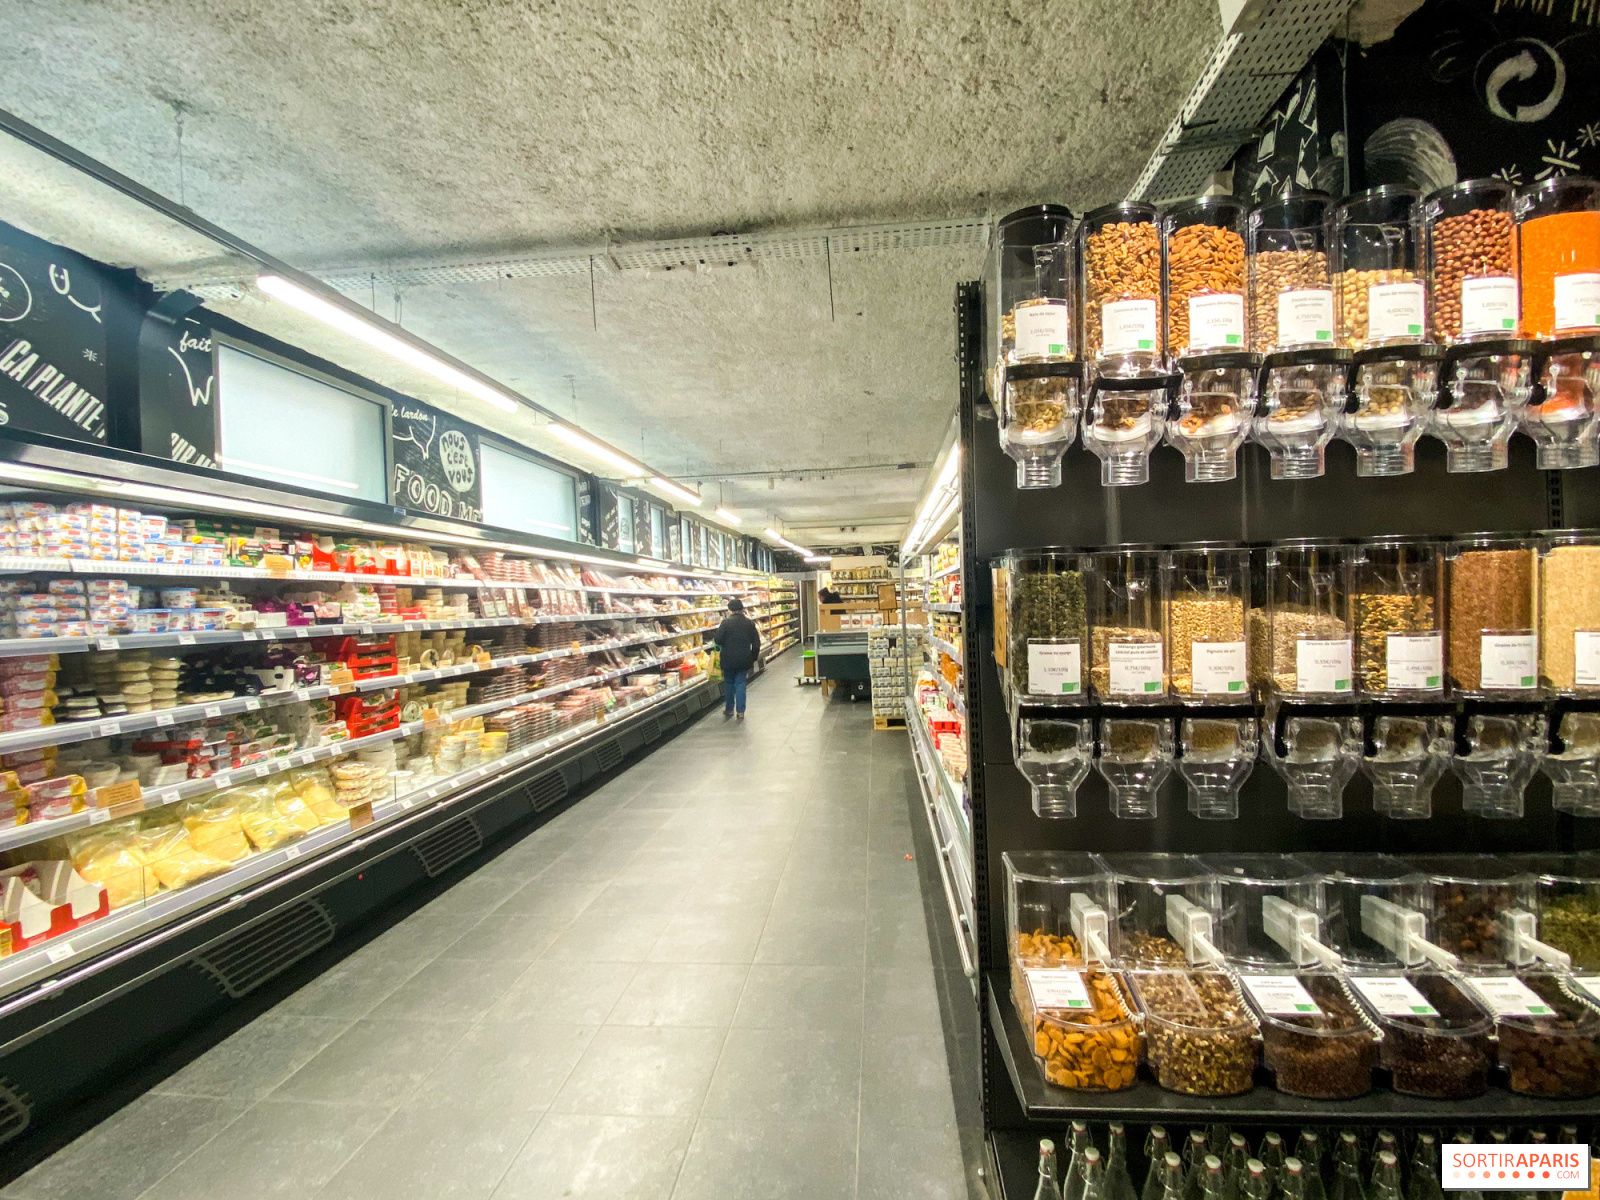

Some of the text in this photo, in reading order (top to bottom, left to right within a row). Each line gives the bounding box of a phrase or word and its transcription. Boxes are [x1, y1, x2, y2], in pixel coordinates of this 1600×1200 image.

[441, 433, 465, 452] nous
[448, 467, 473, 483] vous
[393, 463, 453, 518] FOOD
